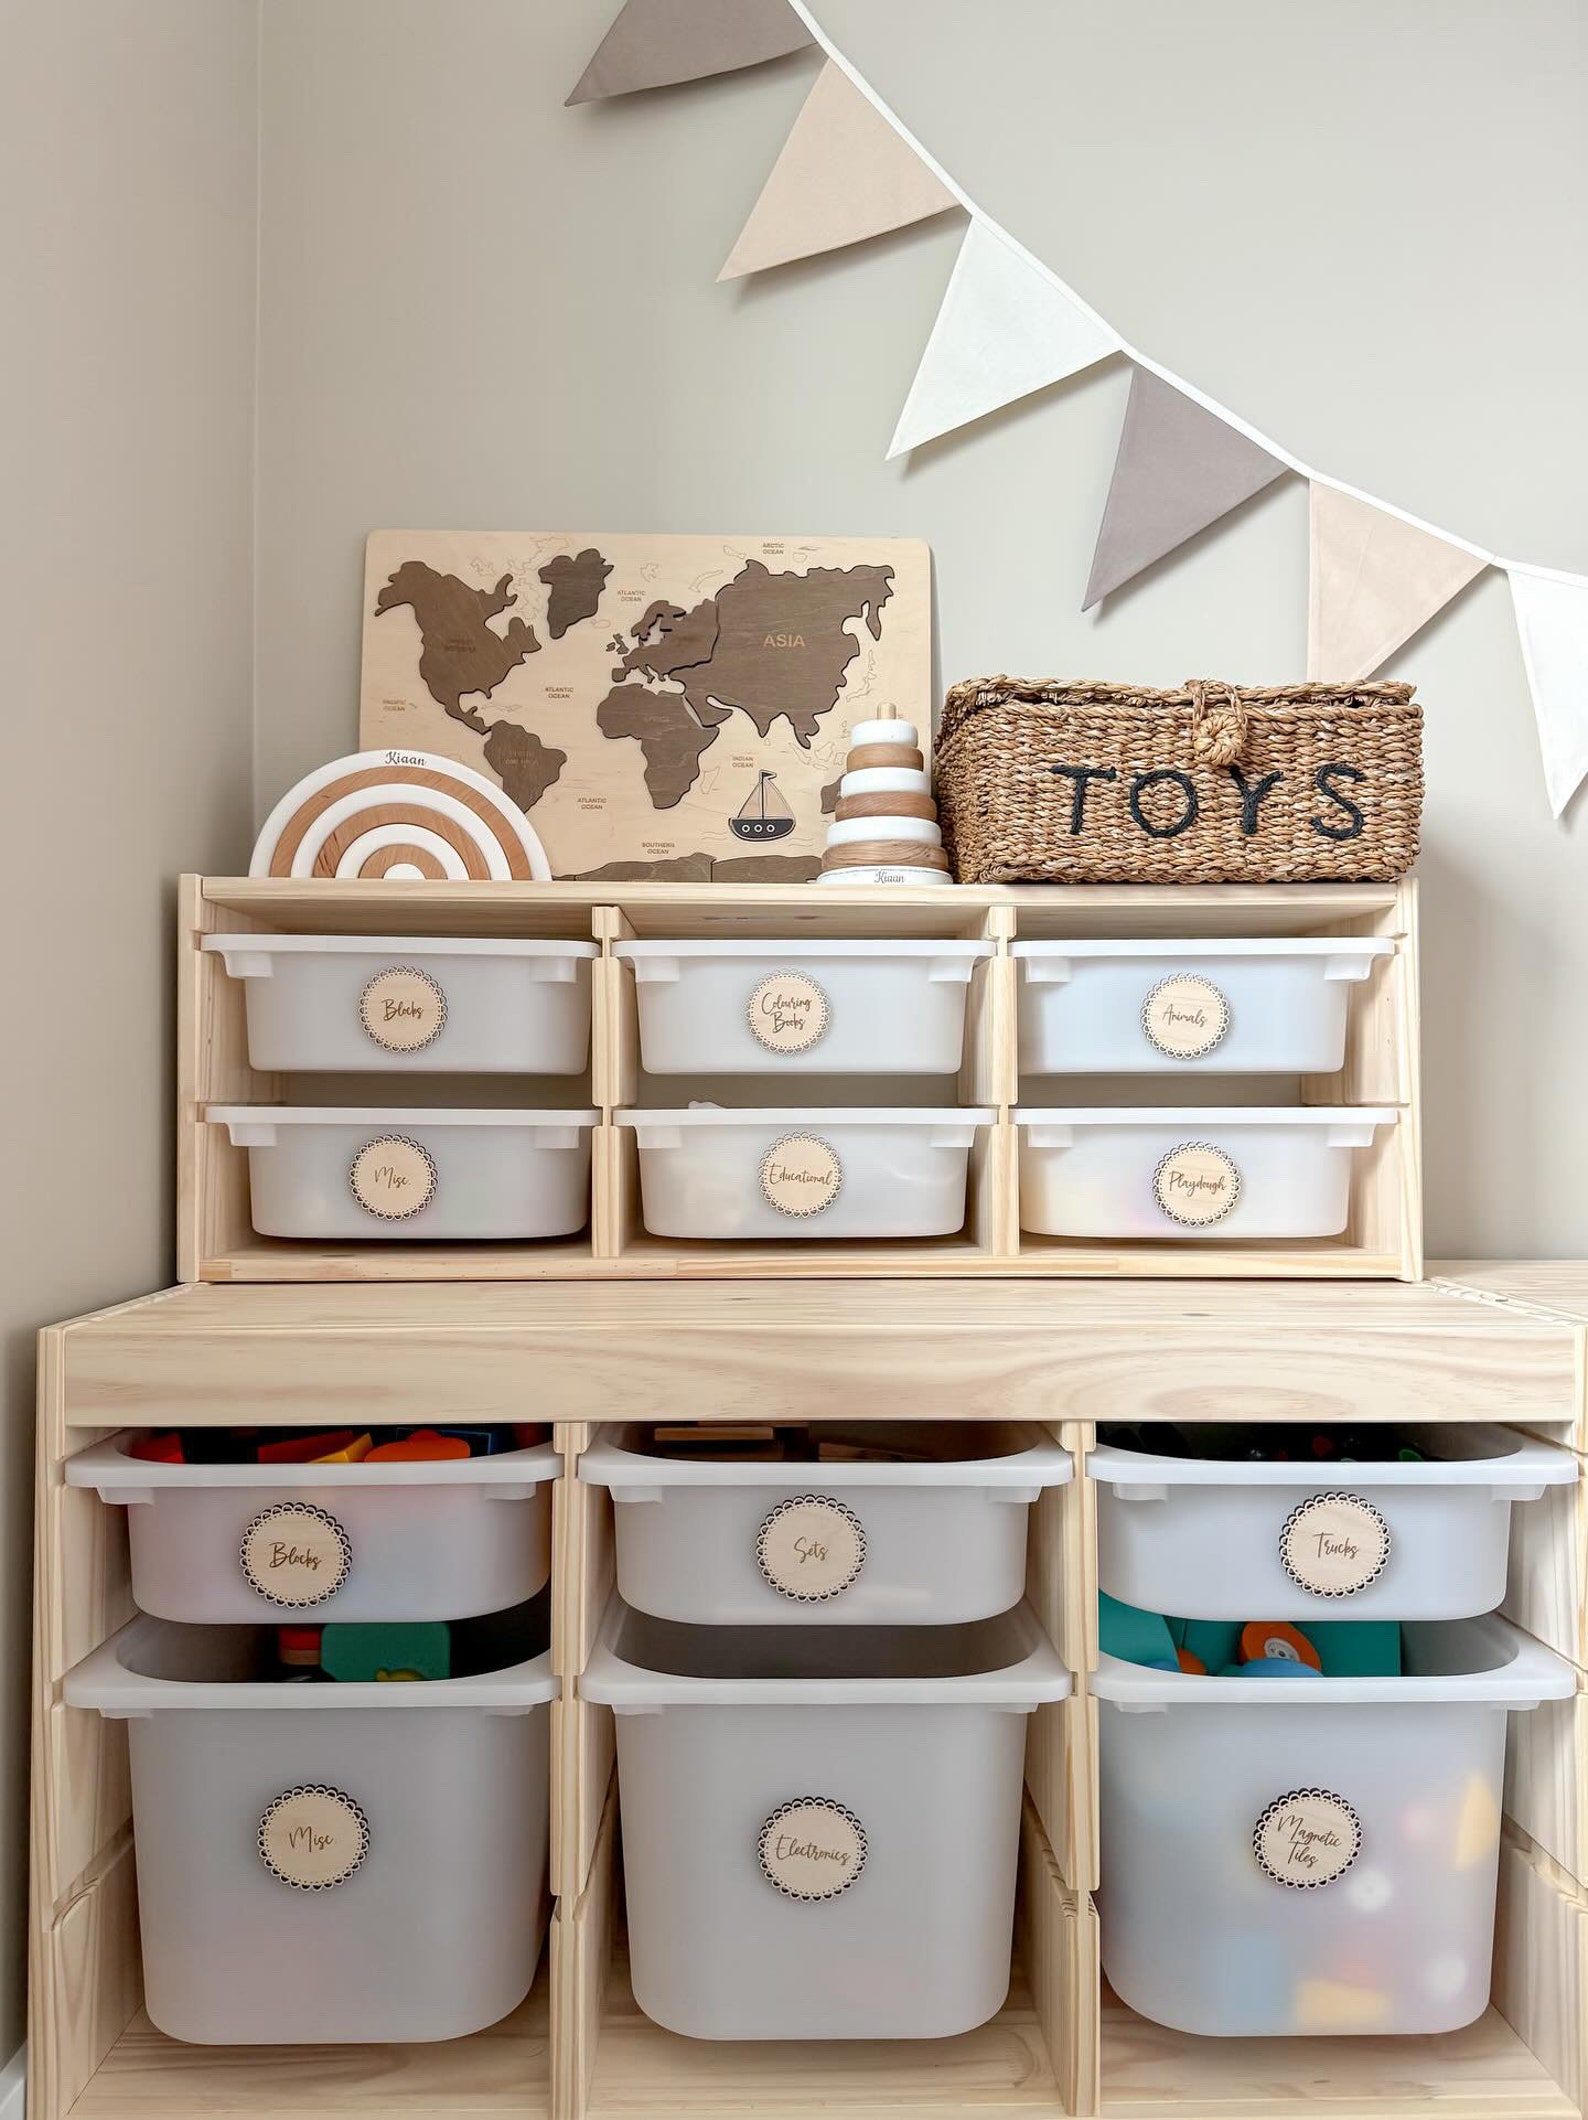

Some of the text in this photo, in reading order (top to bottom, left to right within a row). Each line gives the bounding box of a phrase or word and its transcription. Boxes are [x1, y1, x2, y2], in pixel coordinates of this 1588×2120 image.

[763, 634, 806, 648] ASIA
[385, 751, 427, 766] Kiaan
[1051, 763, 1366, 839] TOYS
[381, 998, 424, 1021] Blocks
[761, 992, 812, 1015] Colouring
[1162, 1003, 1208, 1028] Animals
[770, 1011, 806, 1034] Books
[374, 1166, 409, 1189] Misc
[769, 1162, 833, 1186] Educational
[1168, 1170, 1227, 1198] Playdough
[269, 1541, 322, 1571] Blocks
[793, 1536, 829, 1564] Sets
[1312, 1532, 1359, 1559] Trucks
[289, 1826, 334, 1853] Misc
[1277, 1814, 1342, 1847] Magnetic
[775, 1834, 851, 1866] Electronics
[1287, 1841, 1319, 1869] Tiles
